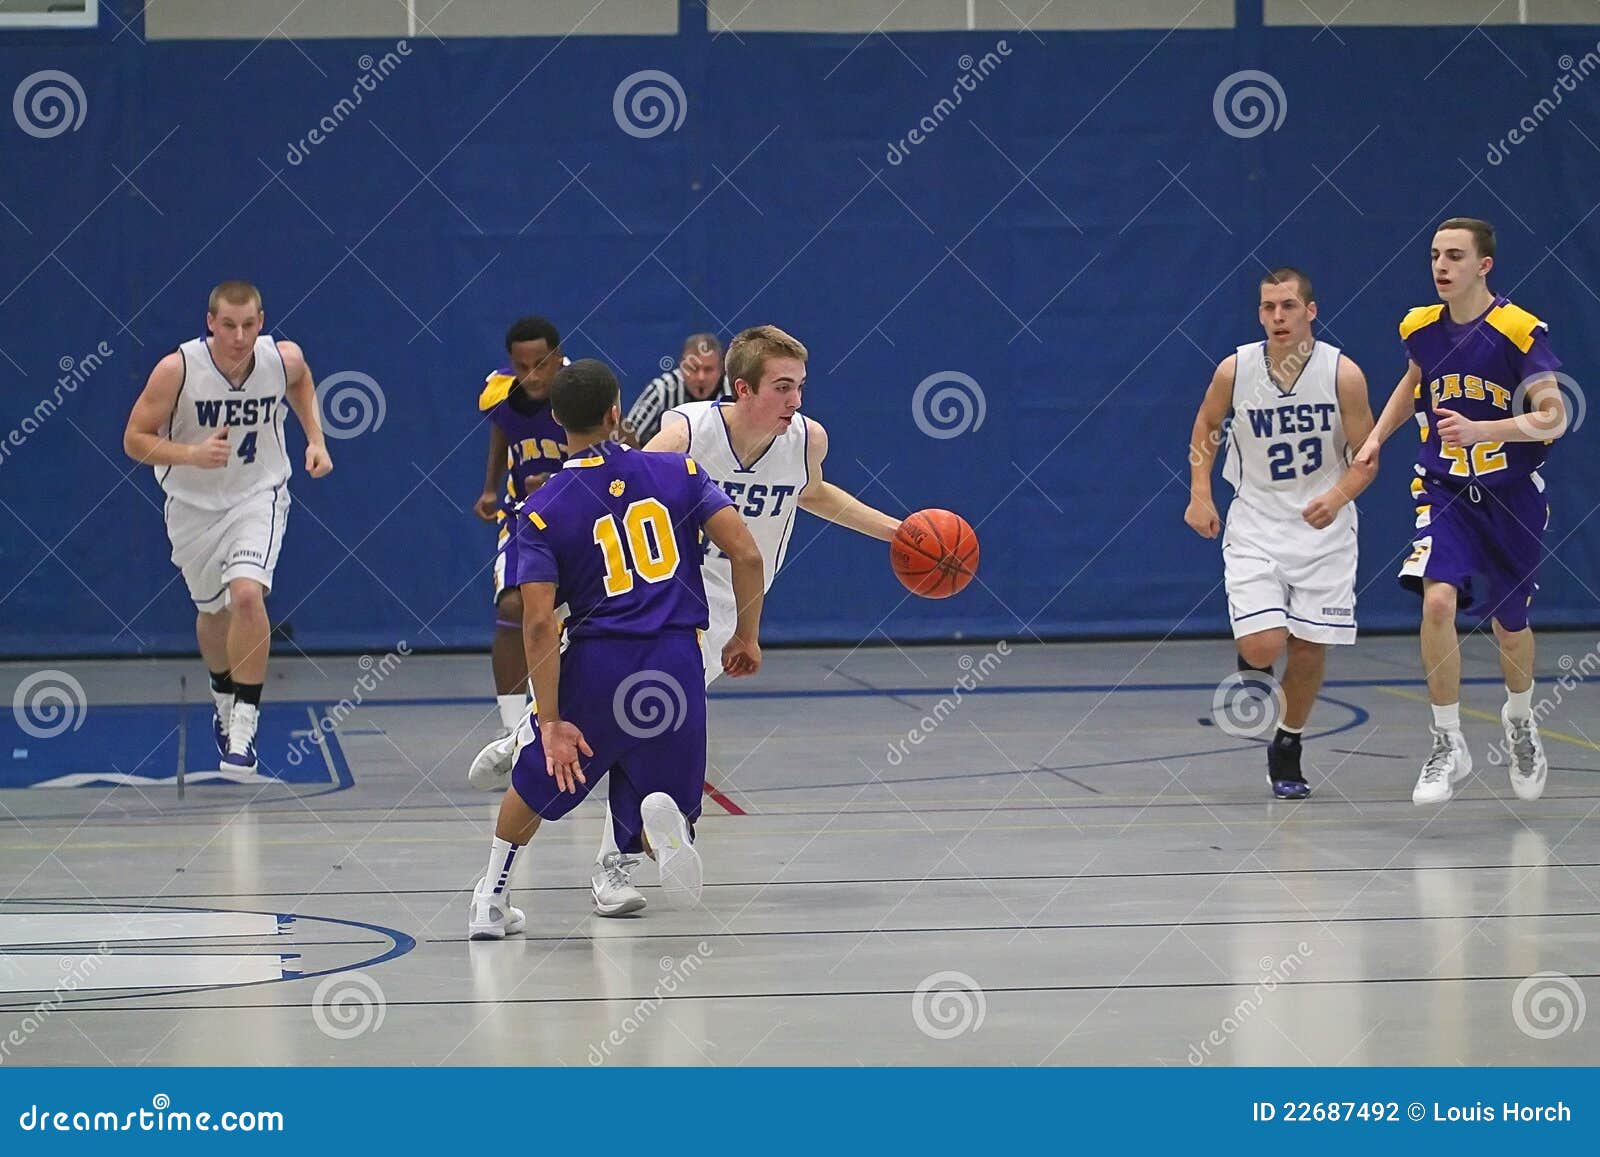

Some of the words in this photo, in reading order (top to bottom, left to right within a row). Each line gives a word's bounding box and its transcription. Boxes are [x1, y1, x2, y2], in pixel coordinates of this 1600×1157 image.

[194, 395, 277, 428] WEST
[1247, 403, 1335, 438] WEST
[1267, 436, 1323, 481] 23
[711, 479, 796, 518] EST
[592, 496, 681, 598] 10
